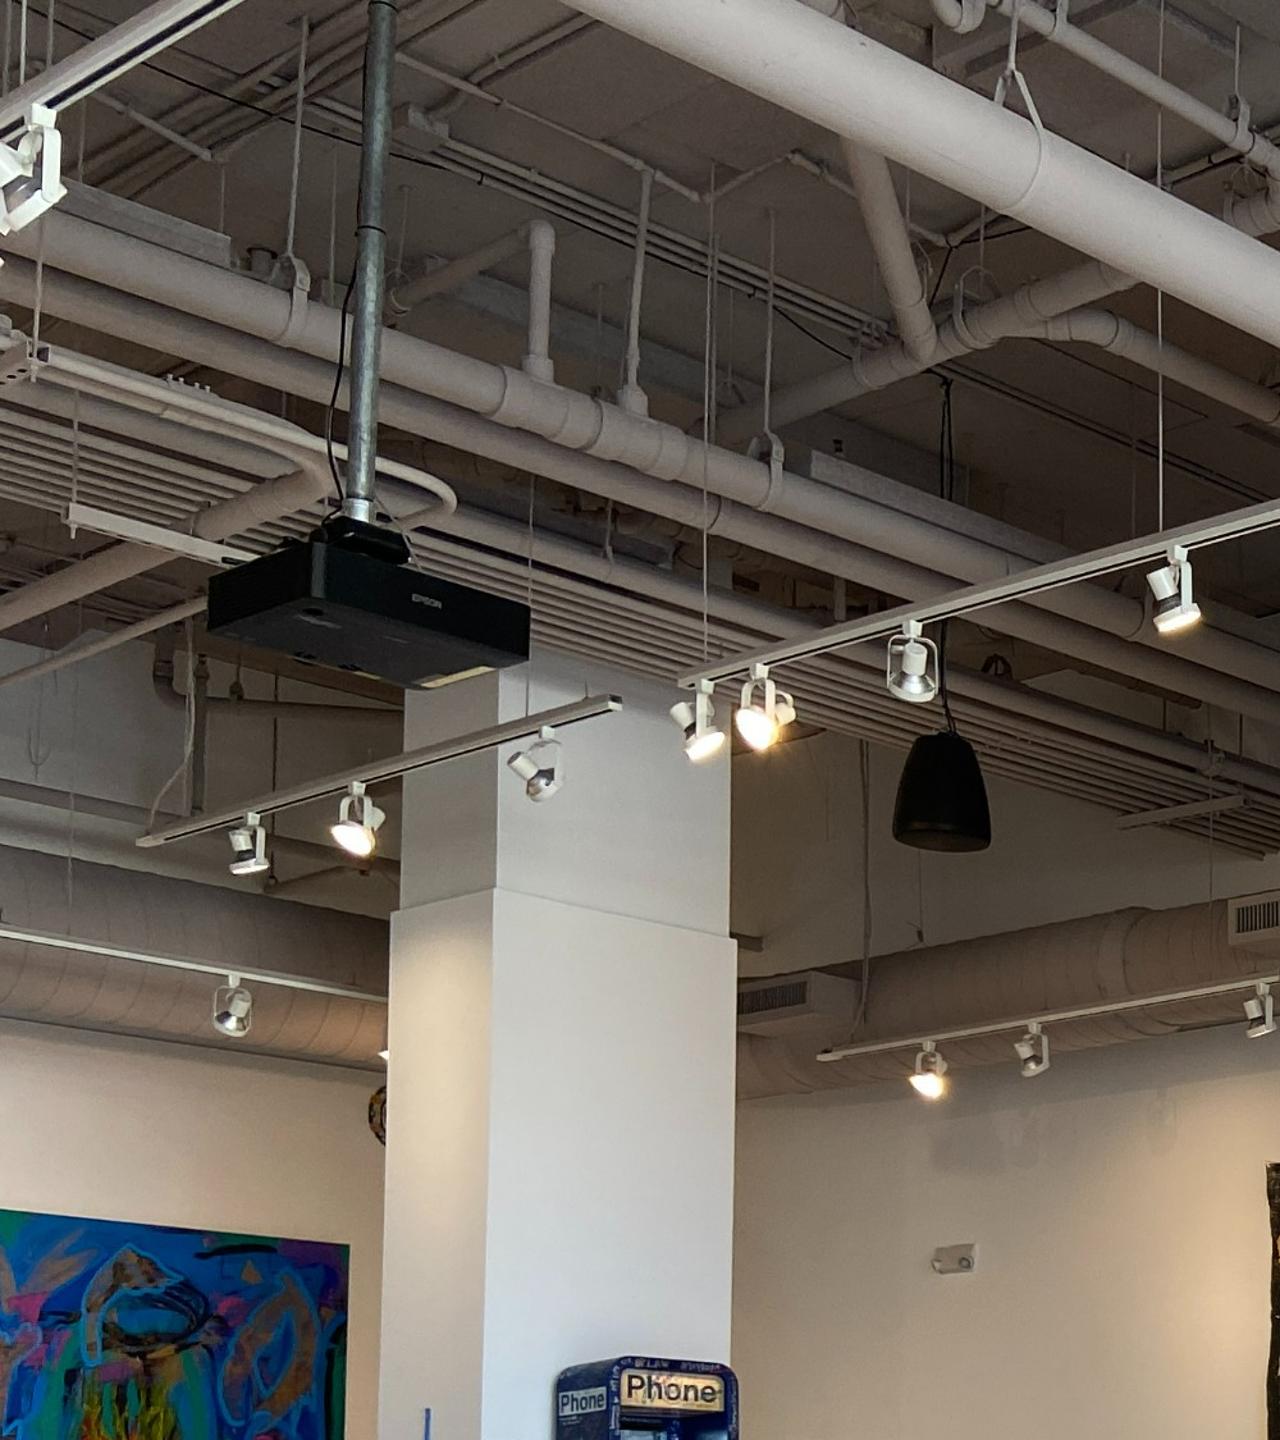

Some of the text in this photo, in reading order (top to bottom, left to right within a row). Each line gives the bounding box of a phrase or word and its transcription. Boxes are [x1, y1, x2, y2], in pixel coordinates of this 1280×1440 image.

[411, 593, 442, 609] EPSON
[626, 1373, 717, 1403] Phone
[560, 1392, 605, 1413] Phone
